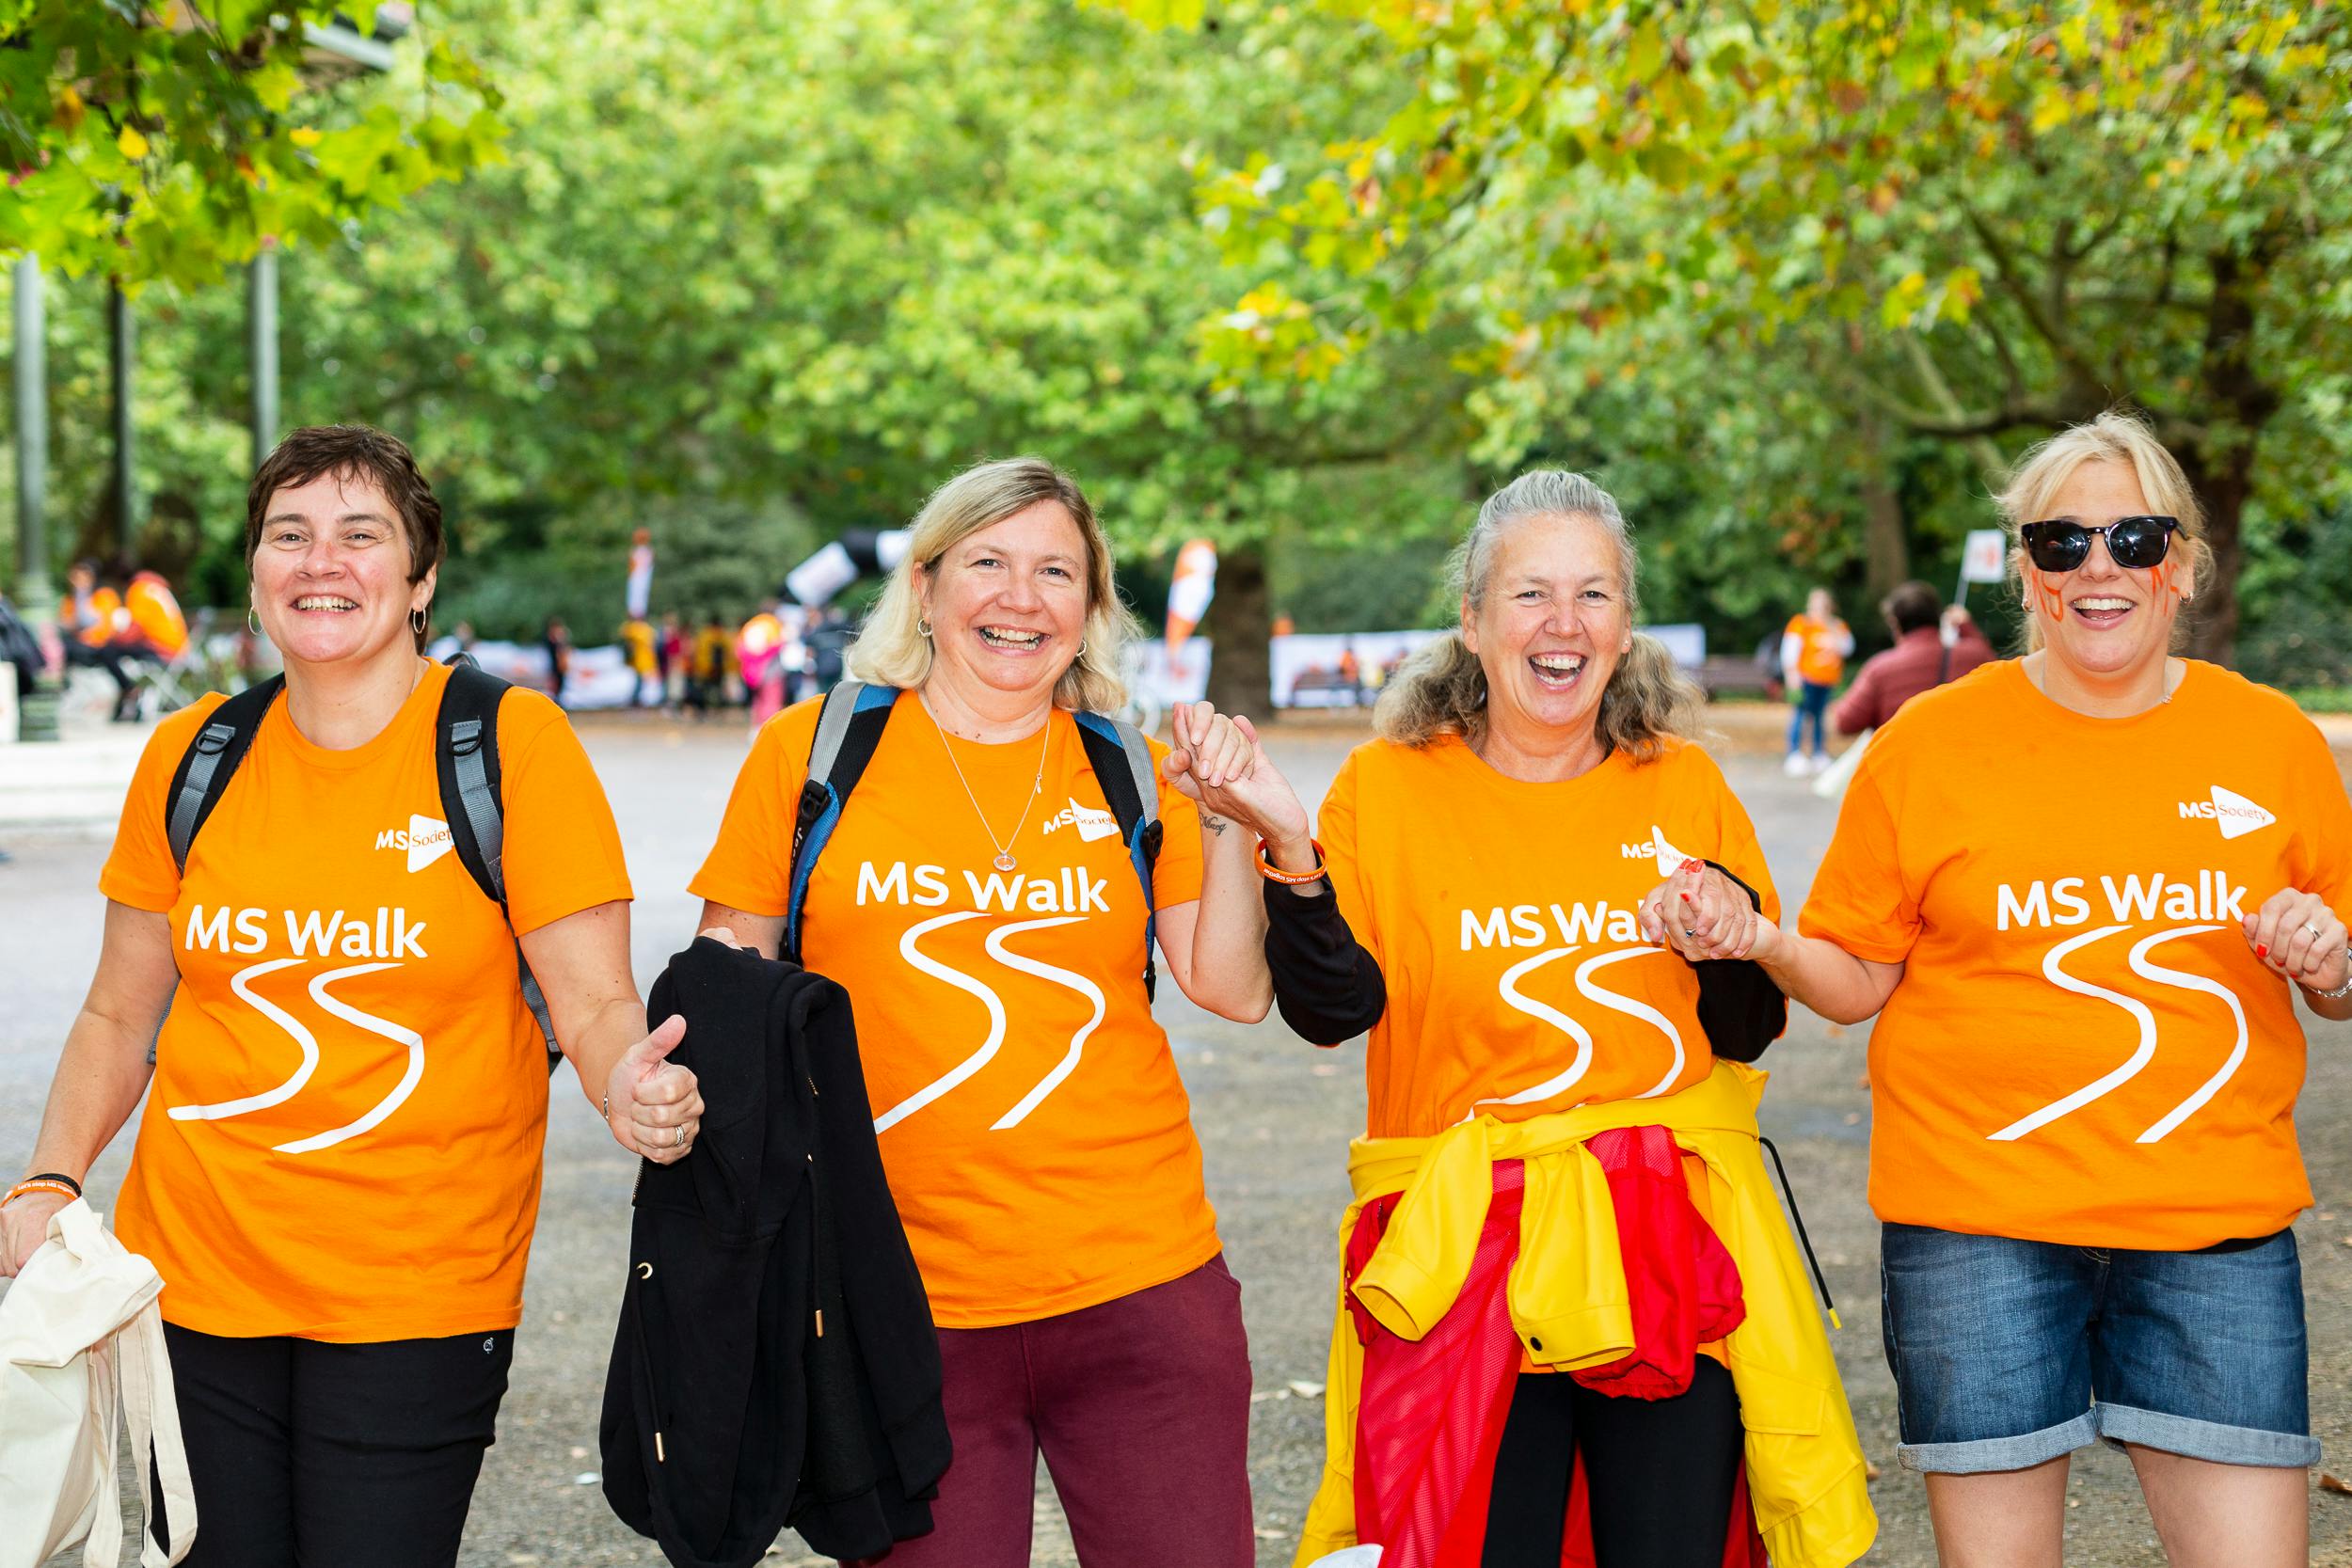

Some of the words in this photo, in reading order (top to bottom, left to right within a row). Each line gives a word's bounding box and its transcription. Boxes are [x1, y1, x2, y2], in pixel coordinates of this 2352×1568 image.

[1043, 808, 1075, 835] MS
[2178, 801, 2217, 819] MS
[2217, 804, 2266, 823] Society
[375, 829, 408, 851] MS
[412, 828, 452, 847] Societ
[1621, 841, 1657, 859] MS
[856, 861, 950, 907] MS
[962, 865, 1110, 912] Walk
[1996, 877, 2090, 931] MS
[2100, 869, 2248, 923] Walk
[185, 904, 268, 954] MS
[283, 906, 428, 958] Walk
[1460, 904, 1547, 951] MS
[1549, 899, 1666, 944] Wa
